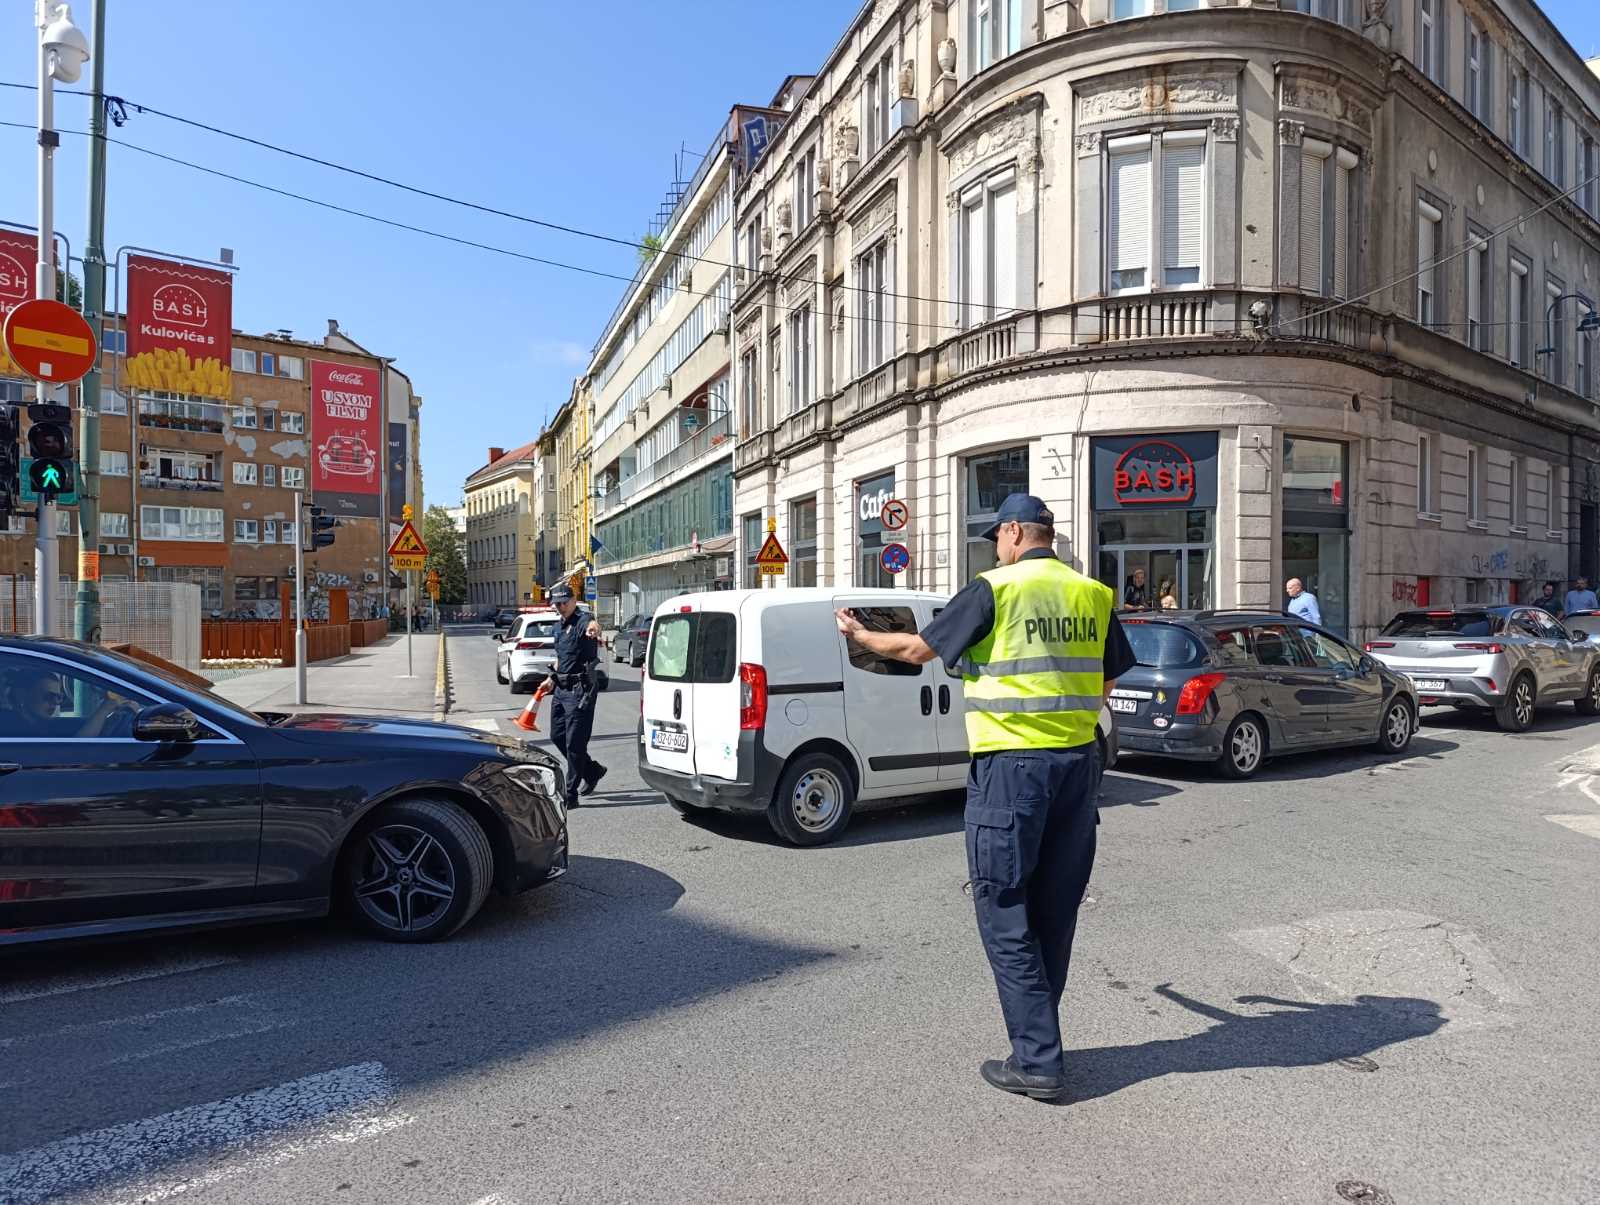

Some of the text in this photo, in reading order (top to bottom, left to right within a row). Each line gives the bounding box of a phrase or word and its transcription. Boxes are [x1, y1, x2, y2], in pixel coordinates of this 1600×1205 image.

[153, 298, 208, 319] BASH
[141, 323, 205, 344] Kulovića
[328, 370, 365, 386] Coca-Cola
[334, 391, 373, 409] SVOM
[325, 403, 368, 421] FILMU
[1114, 468, 1194, 489] BASH
[396, 559, 412, 567] 100
[762, 565, 775, 573] 100
[1024, 616, 1098, 645] POLICIJA
